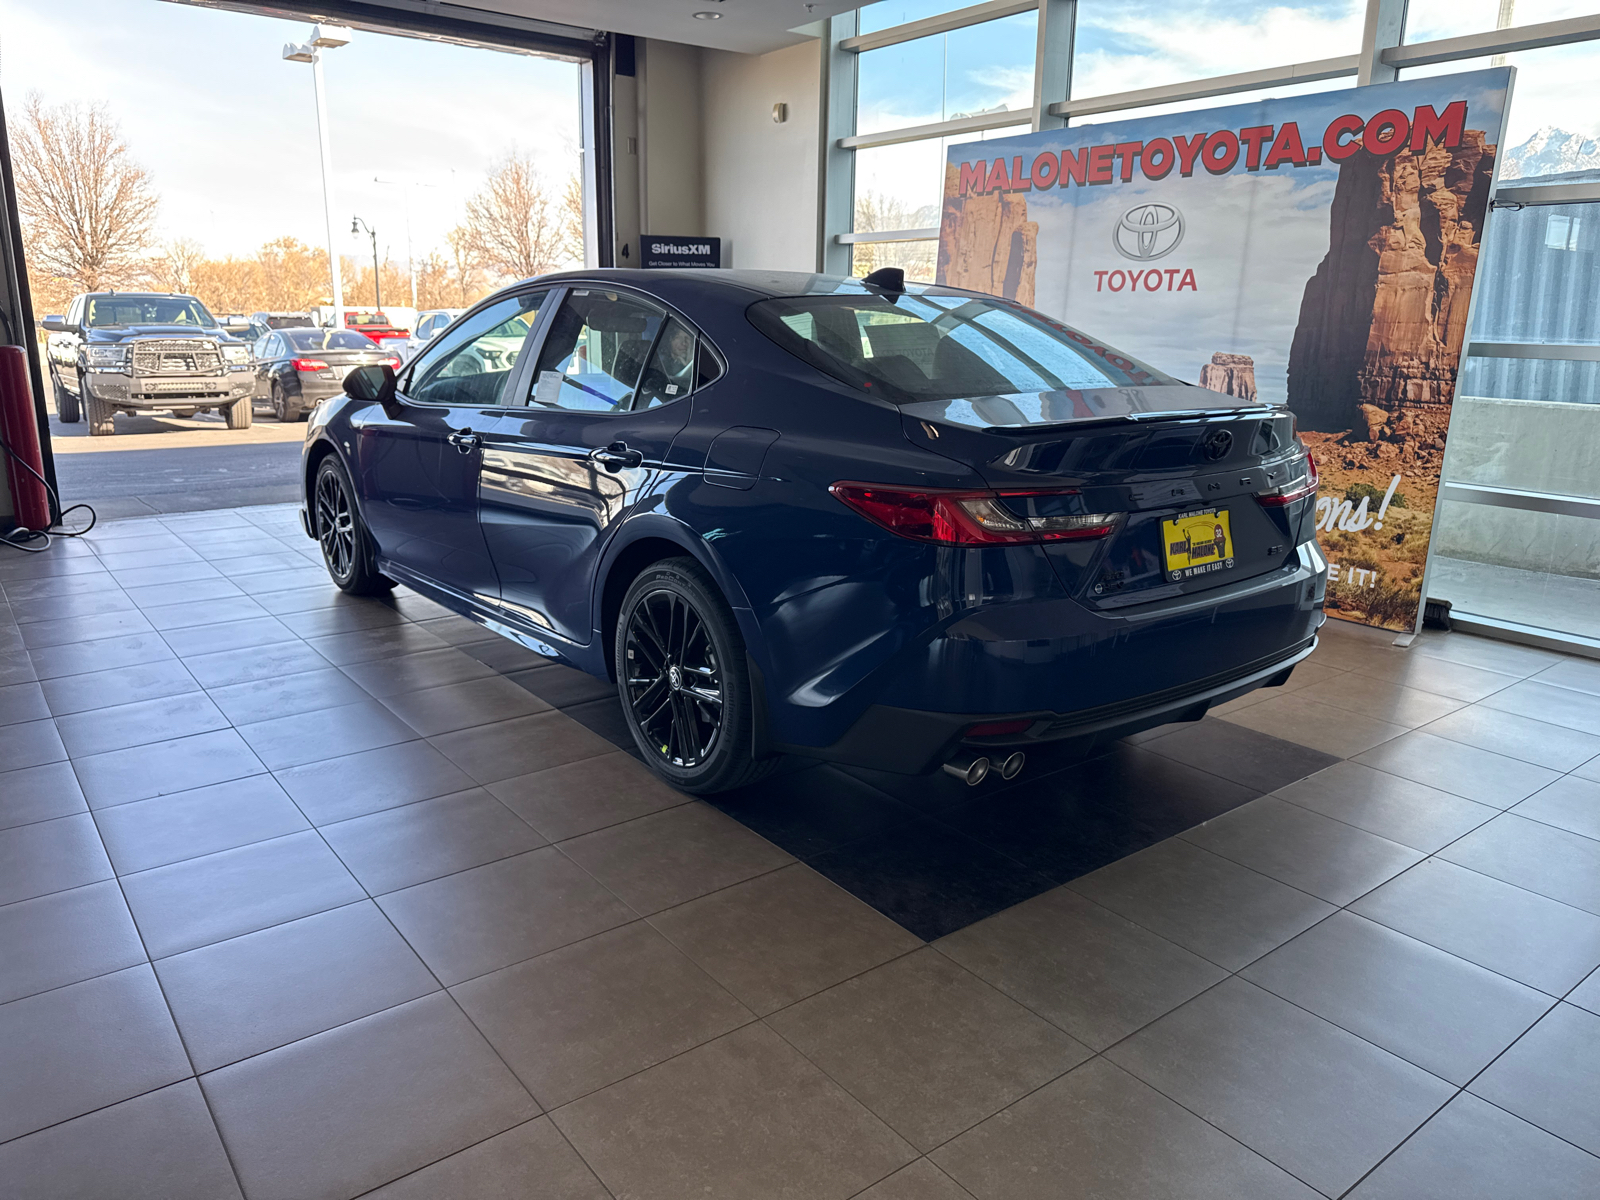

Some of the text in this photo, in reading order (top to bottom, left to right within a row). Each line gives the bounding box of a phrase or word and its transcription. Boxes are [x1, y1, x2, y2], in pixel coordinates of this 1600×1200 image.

[958, 101, 1468, 197] MALONETOYOTA.COM
[622, 243, 629, 259] 4
[651, 243, 710, 255] SiriusXM
[1093, 269, 1198, 292] TOYOTA
[1204, 508, 1216, 516] TOYOTA
[1216, 529, 1222, 538] 32
[1170, 541, 1187, 556] KARL
[1192, 544, 1215, 559] MALONE
[1185, 562, 1223, 577] WE MAKE IT EASY
[1347, 567, 1377, 589] IT!
